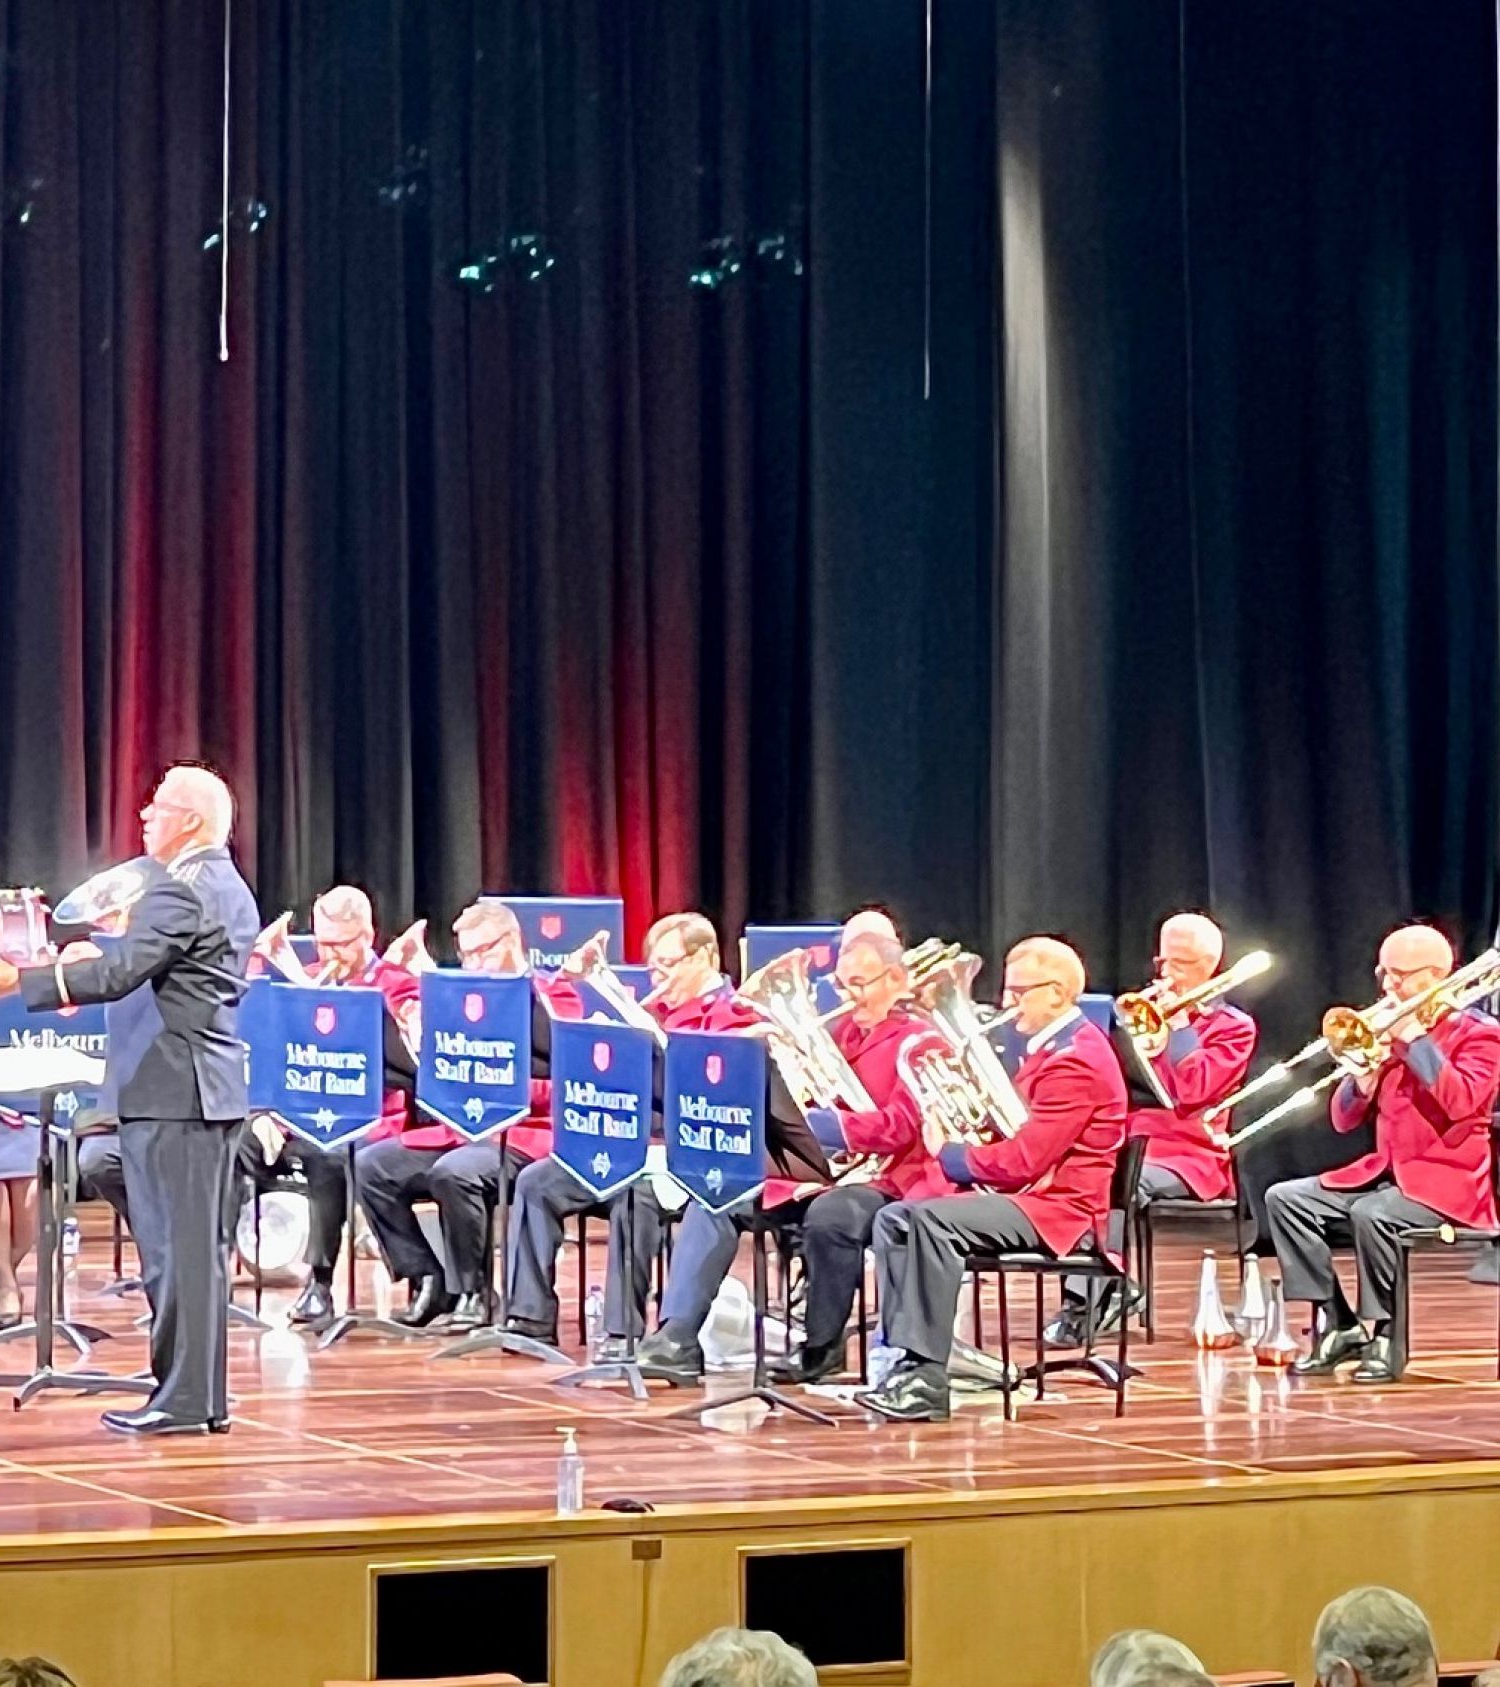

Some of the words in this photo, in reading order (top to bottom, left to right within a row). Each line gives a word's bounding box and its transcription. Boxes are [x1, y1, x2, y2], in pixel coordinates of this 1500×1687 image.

[285, 1043, 367, 1069] Melbourne
[435, 1031, 516, 1058] Melbourne
[285, 1068, 323, 1093] Staff
[325, 1071, 366, 1096] Band
[435, 1057, 472, 1083] Staff
[474, 1060, 514, 1085] Band
[564, 1079, 638, 1111] Melbourne
[564, 1108, 601, 1136] Staff
[603, 1112, 638, 1139] Band
[679, 1094, 752, 1126] Melbourne
[679, 1122, 712, 1151] Staff
[715, 1128, 751, 1155] Band
